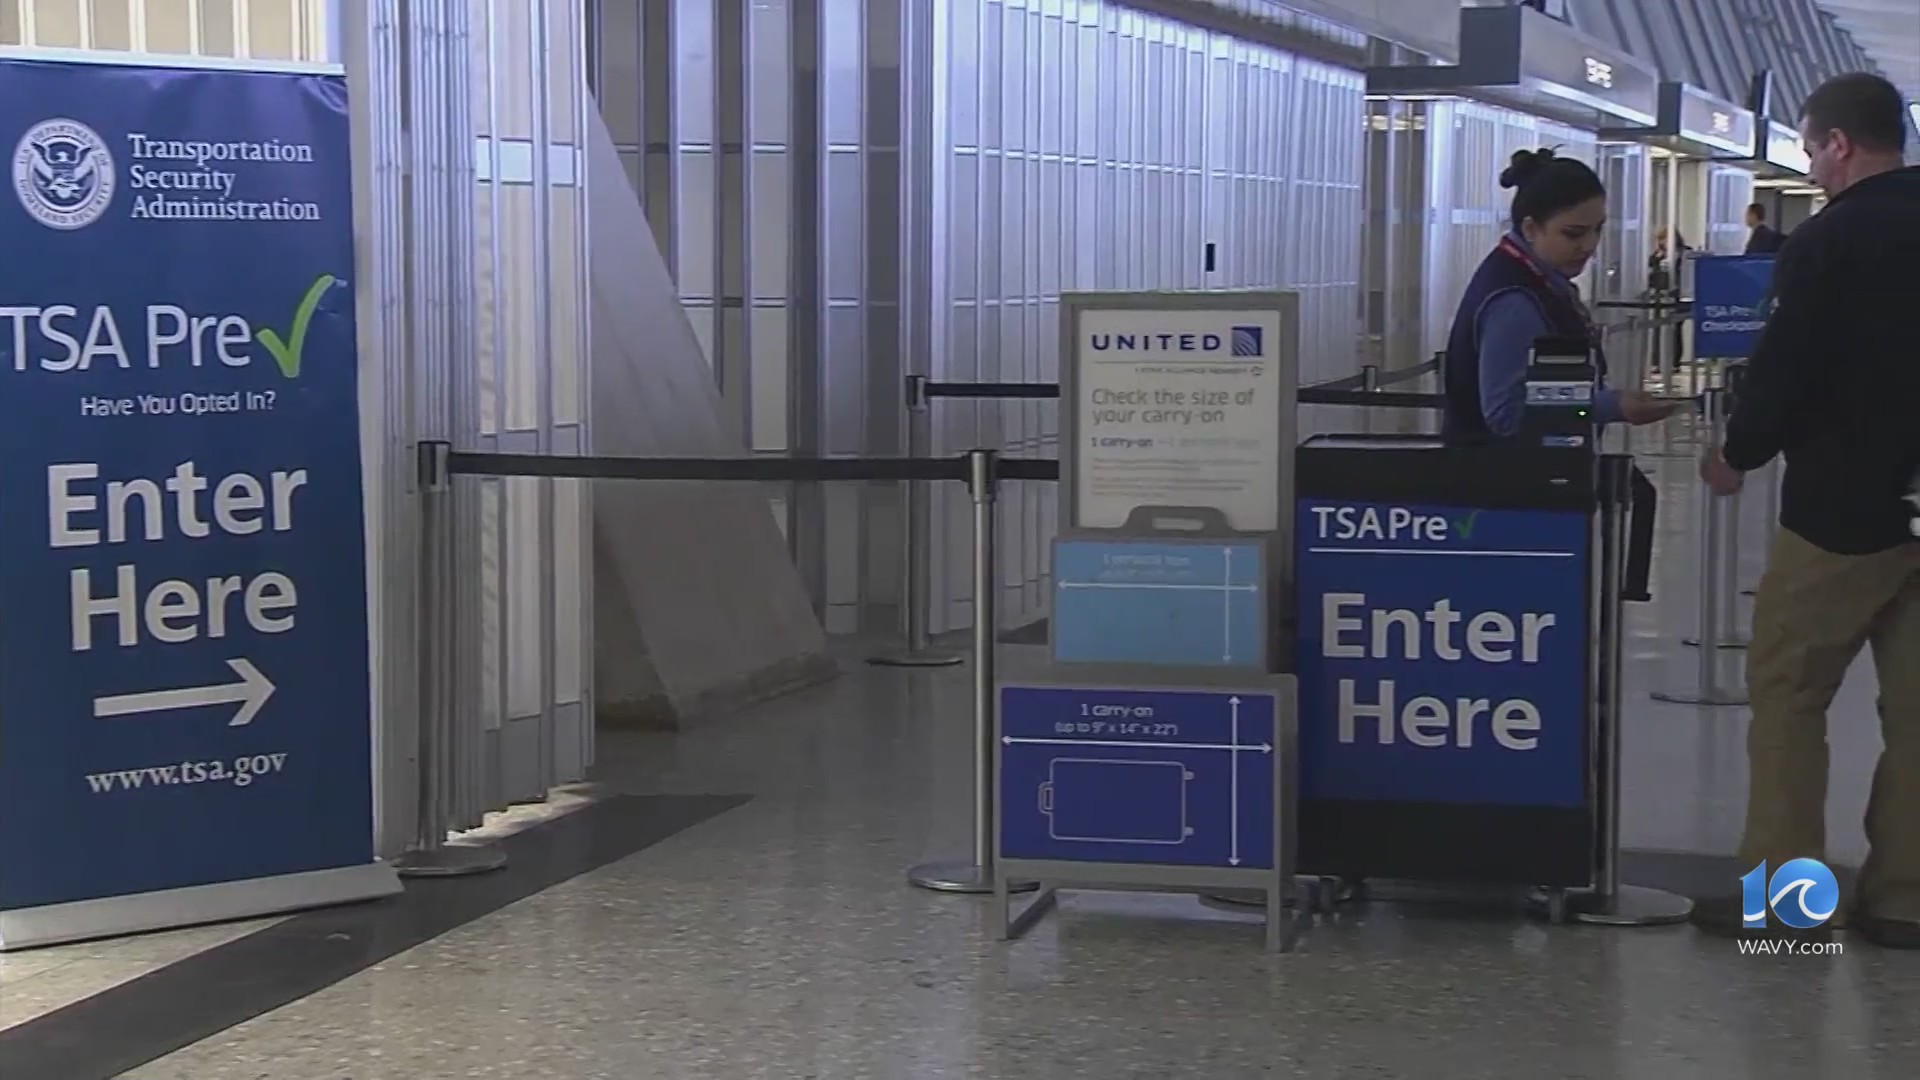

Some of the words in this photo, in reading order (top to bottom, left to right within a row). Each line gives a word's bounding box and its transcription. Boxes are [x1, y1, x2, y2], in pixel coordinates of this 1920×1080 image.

[127, 133, 314, 164] Transportation
[130, 166, 235, 194] Security
[131, 194, 320, 220] Administration
[0, 304, 131, 371] TSA
[147, 304, 251, 368] Pre
[1091, 334, 1221, 351] UNITED
[80, 396, 135, 416] Have
[136, 394, 176, 414] You
[179, 391, 240, 415] Opted
[246, 391, 277, 410] In?
[1092, 388, 1148, 405] Check
[1154, 389, 1185, 405] the
[1191, 390, 1229, 406] size
[1235, 389, 1254, 406] of
[1092, 409, 1136, 425] your
[1141, 409, 1225, 425] carry-on
[48, 461, 307, 547] Enter
[1311, 507, 1384, 539] TSA
[1389, 509, 1448, 540] Pre
[70, 564, 297, 651] Here
[1322, 592, 1555, 663] Enter
[1081, 703, 1089, 716] 1
[1092, 705, 1153, 717] carry-on
[1338, 678, 1541, 750] Here
[86, 753, 287, 793] www.tsa.gov
